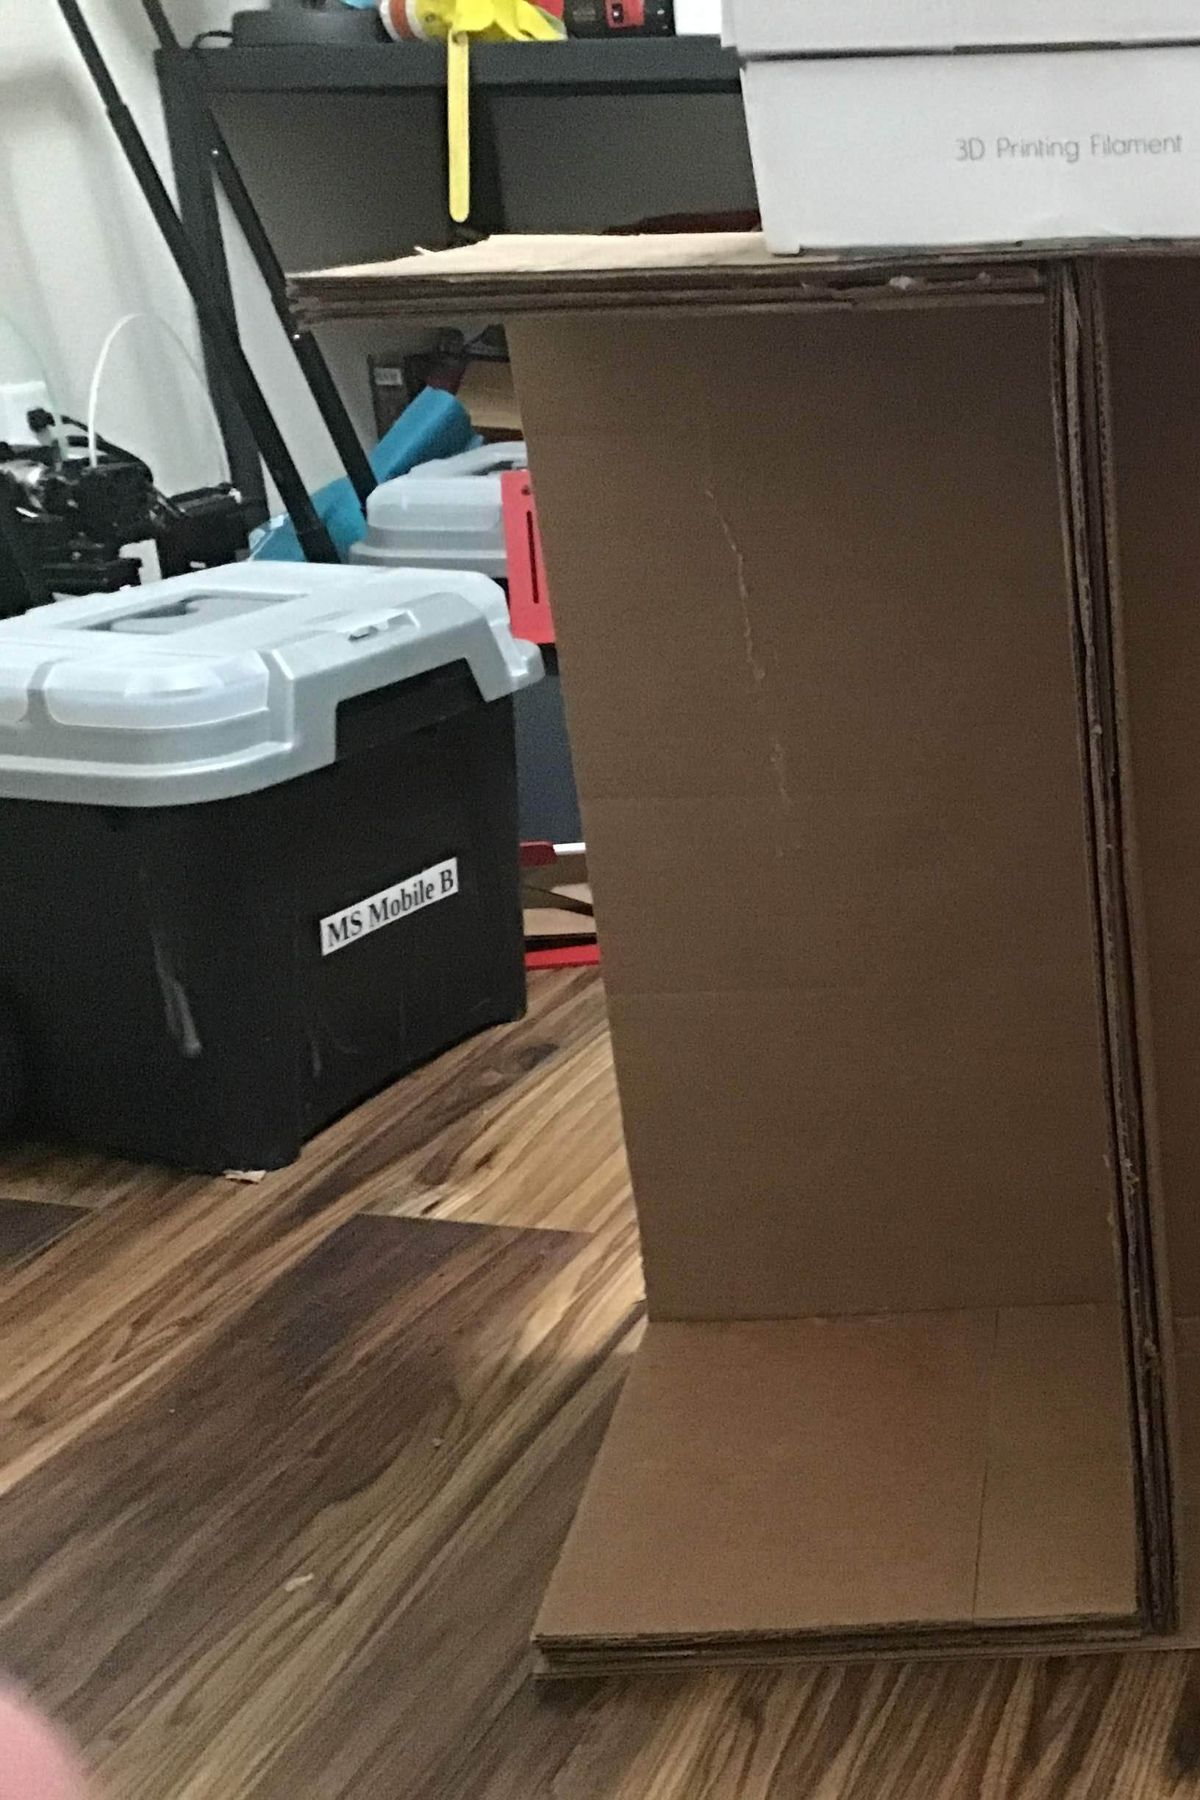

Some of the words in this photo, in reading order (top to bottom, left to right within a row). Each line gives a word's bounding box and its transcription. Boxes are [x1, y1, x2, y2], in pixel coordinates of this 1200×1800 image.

[956, 137, 985, 161] 3D
[996, 136, 1080, 164] Printing
[1090, 134, 1183, 157] Filament
[327, 910, 363, 947] MS
[368, 879, 435, 927] Mobile
[439, 868, 454, 894] B
